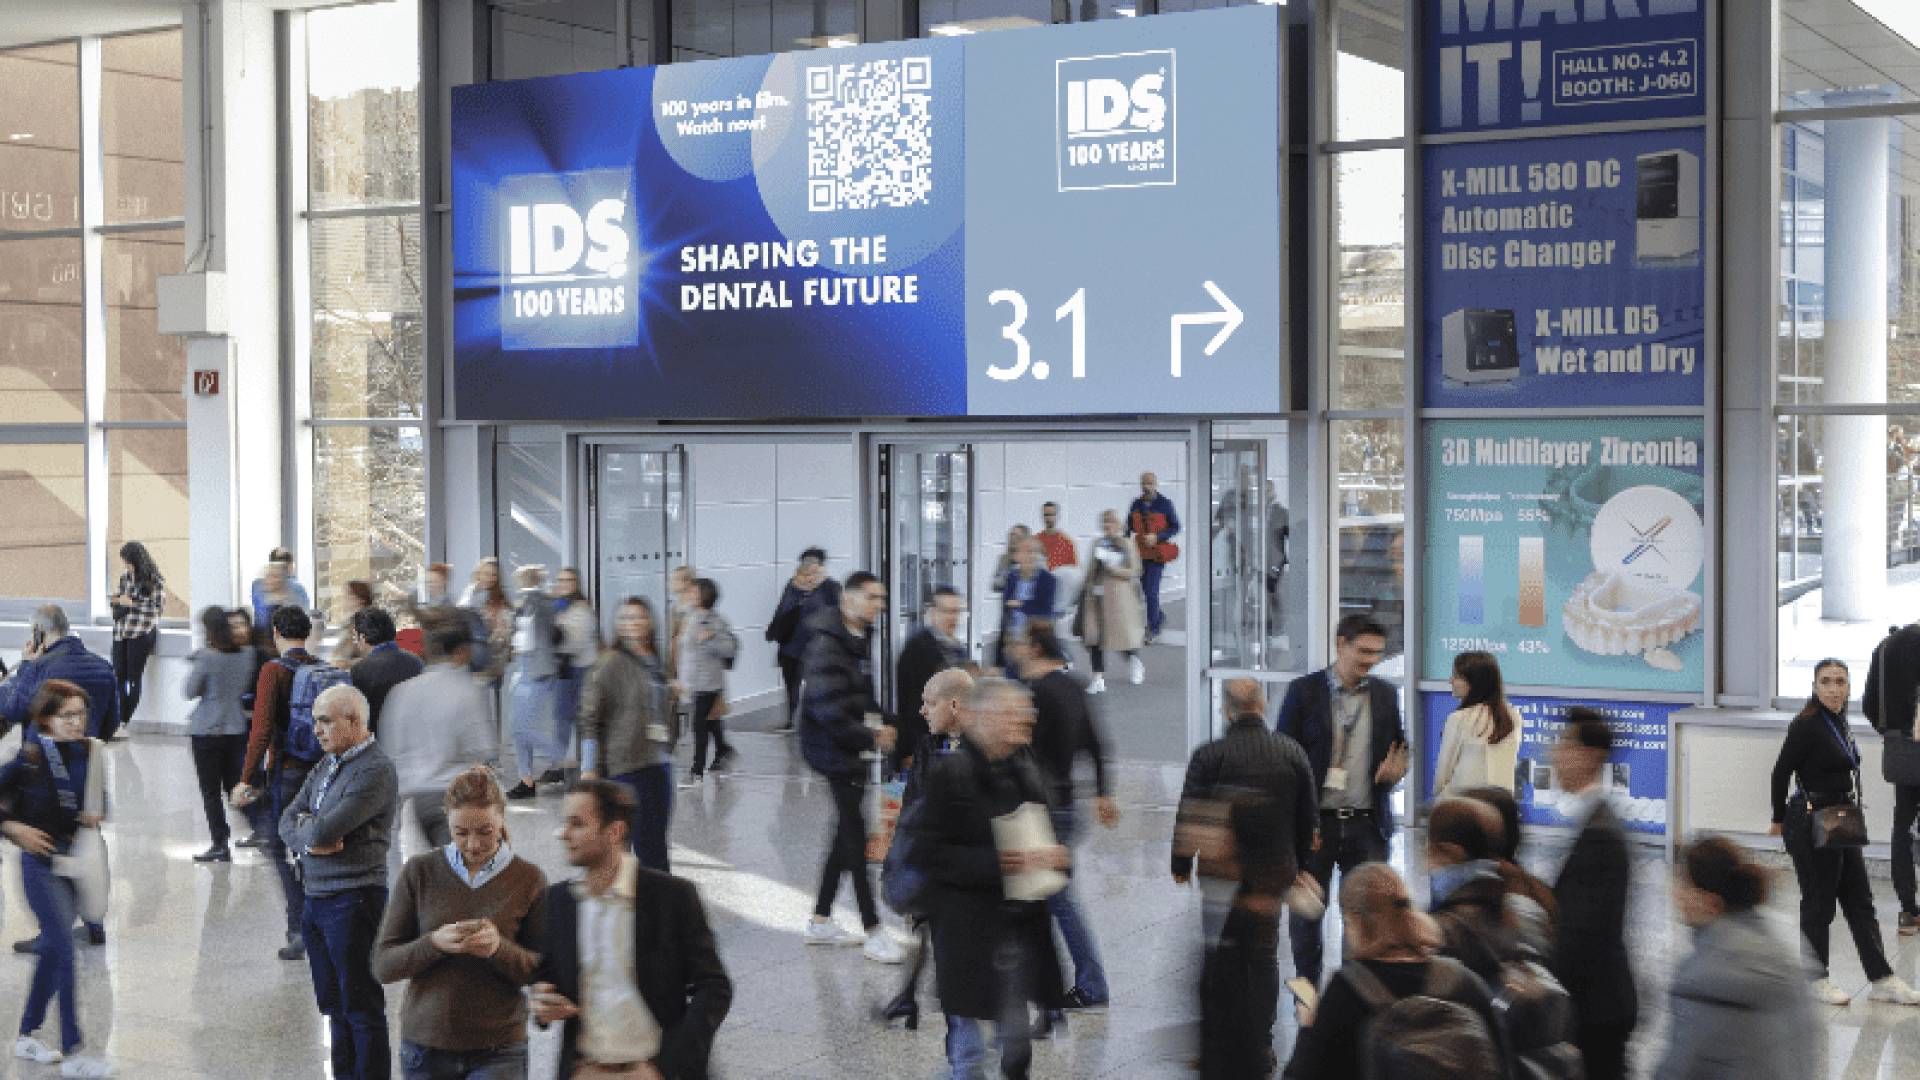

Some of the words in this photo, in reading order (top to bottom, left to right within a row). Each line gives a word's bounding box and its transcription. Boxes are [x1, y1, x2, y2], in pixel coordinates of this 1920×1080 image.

[1561, 57, 1609, 75] HALL
[1612, 52, 1655, 71] NO.:
[1658, 50, 1688, 67] 4.2
[1440, 40, 1541, 127] IT!
[1561, 76, 1635, 97] BOOTH:
[1639, 71, 1691, 92] J-060
[660, 100, 687, 116] 100
[691, 100, 732, 118] years
[737, 93, 751, 110] in
[1067, 73, 1167, 132] IDS
[676, 117, 723, 137] Watch
[727, 115, 766, 133] now!
[1067, 143, 1102, 166] 100
[1106, 139, 1164, 164] YEARS
[1441, 164, 1522, 198] X-MILL
[1528, 161, 1578, 192] 580
[1586, 157, 1621, 188] DC
[1441, 201, 1573, 234] Automatic
[508, 197, 630, 276] IDS
[681, 239, 820, 273] SHAPING
[829, 234, 887, 266] THE
[1441, 242, 1498, 270] Disc
[1504, 239, 1616, 270] Changer
[513, 289, 553, 317] 100
[556, 285, 625, 315] YEARS
[681, 280, 793, 312] DENTAL
[803, 274, 919, 306] FUTURE
[986, 287, 1086, 382] 3.1
[1535, 306, 1618, 337] X-MILL
[1625, 304, 1659, 334] D5
[1535, 346, 1587, 375] Wet
[1593, 344, 1642, 373] and
[1651, 343, 1695, 375] Dry
[1441, 437, 1470, 466] 3D
[1475, 436, 1592, 468] Multilayer
[1600, 436, 1697, 466] Zirconia
[1517, 640, 1551, 654] 43%
